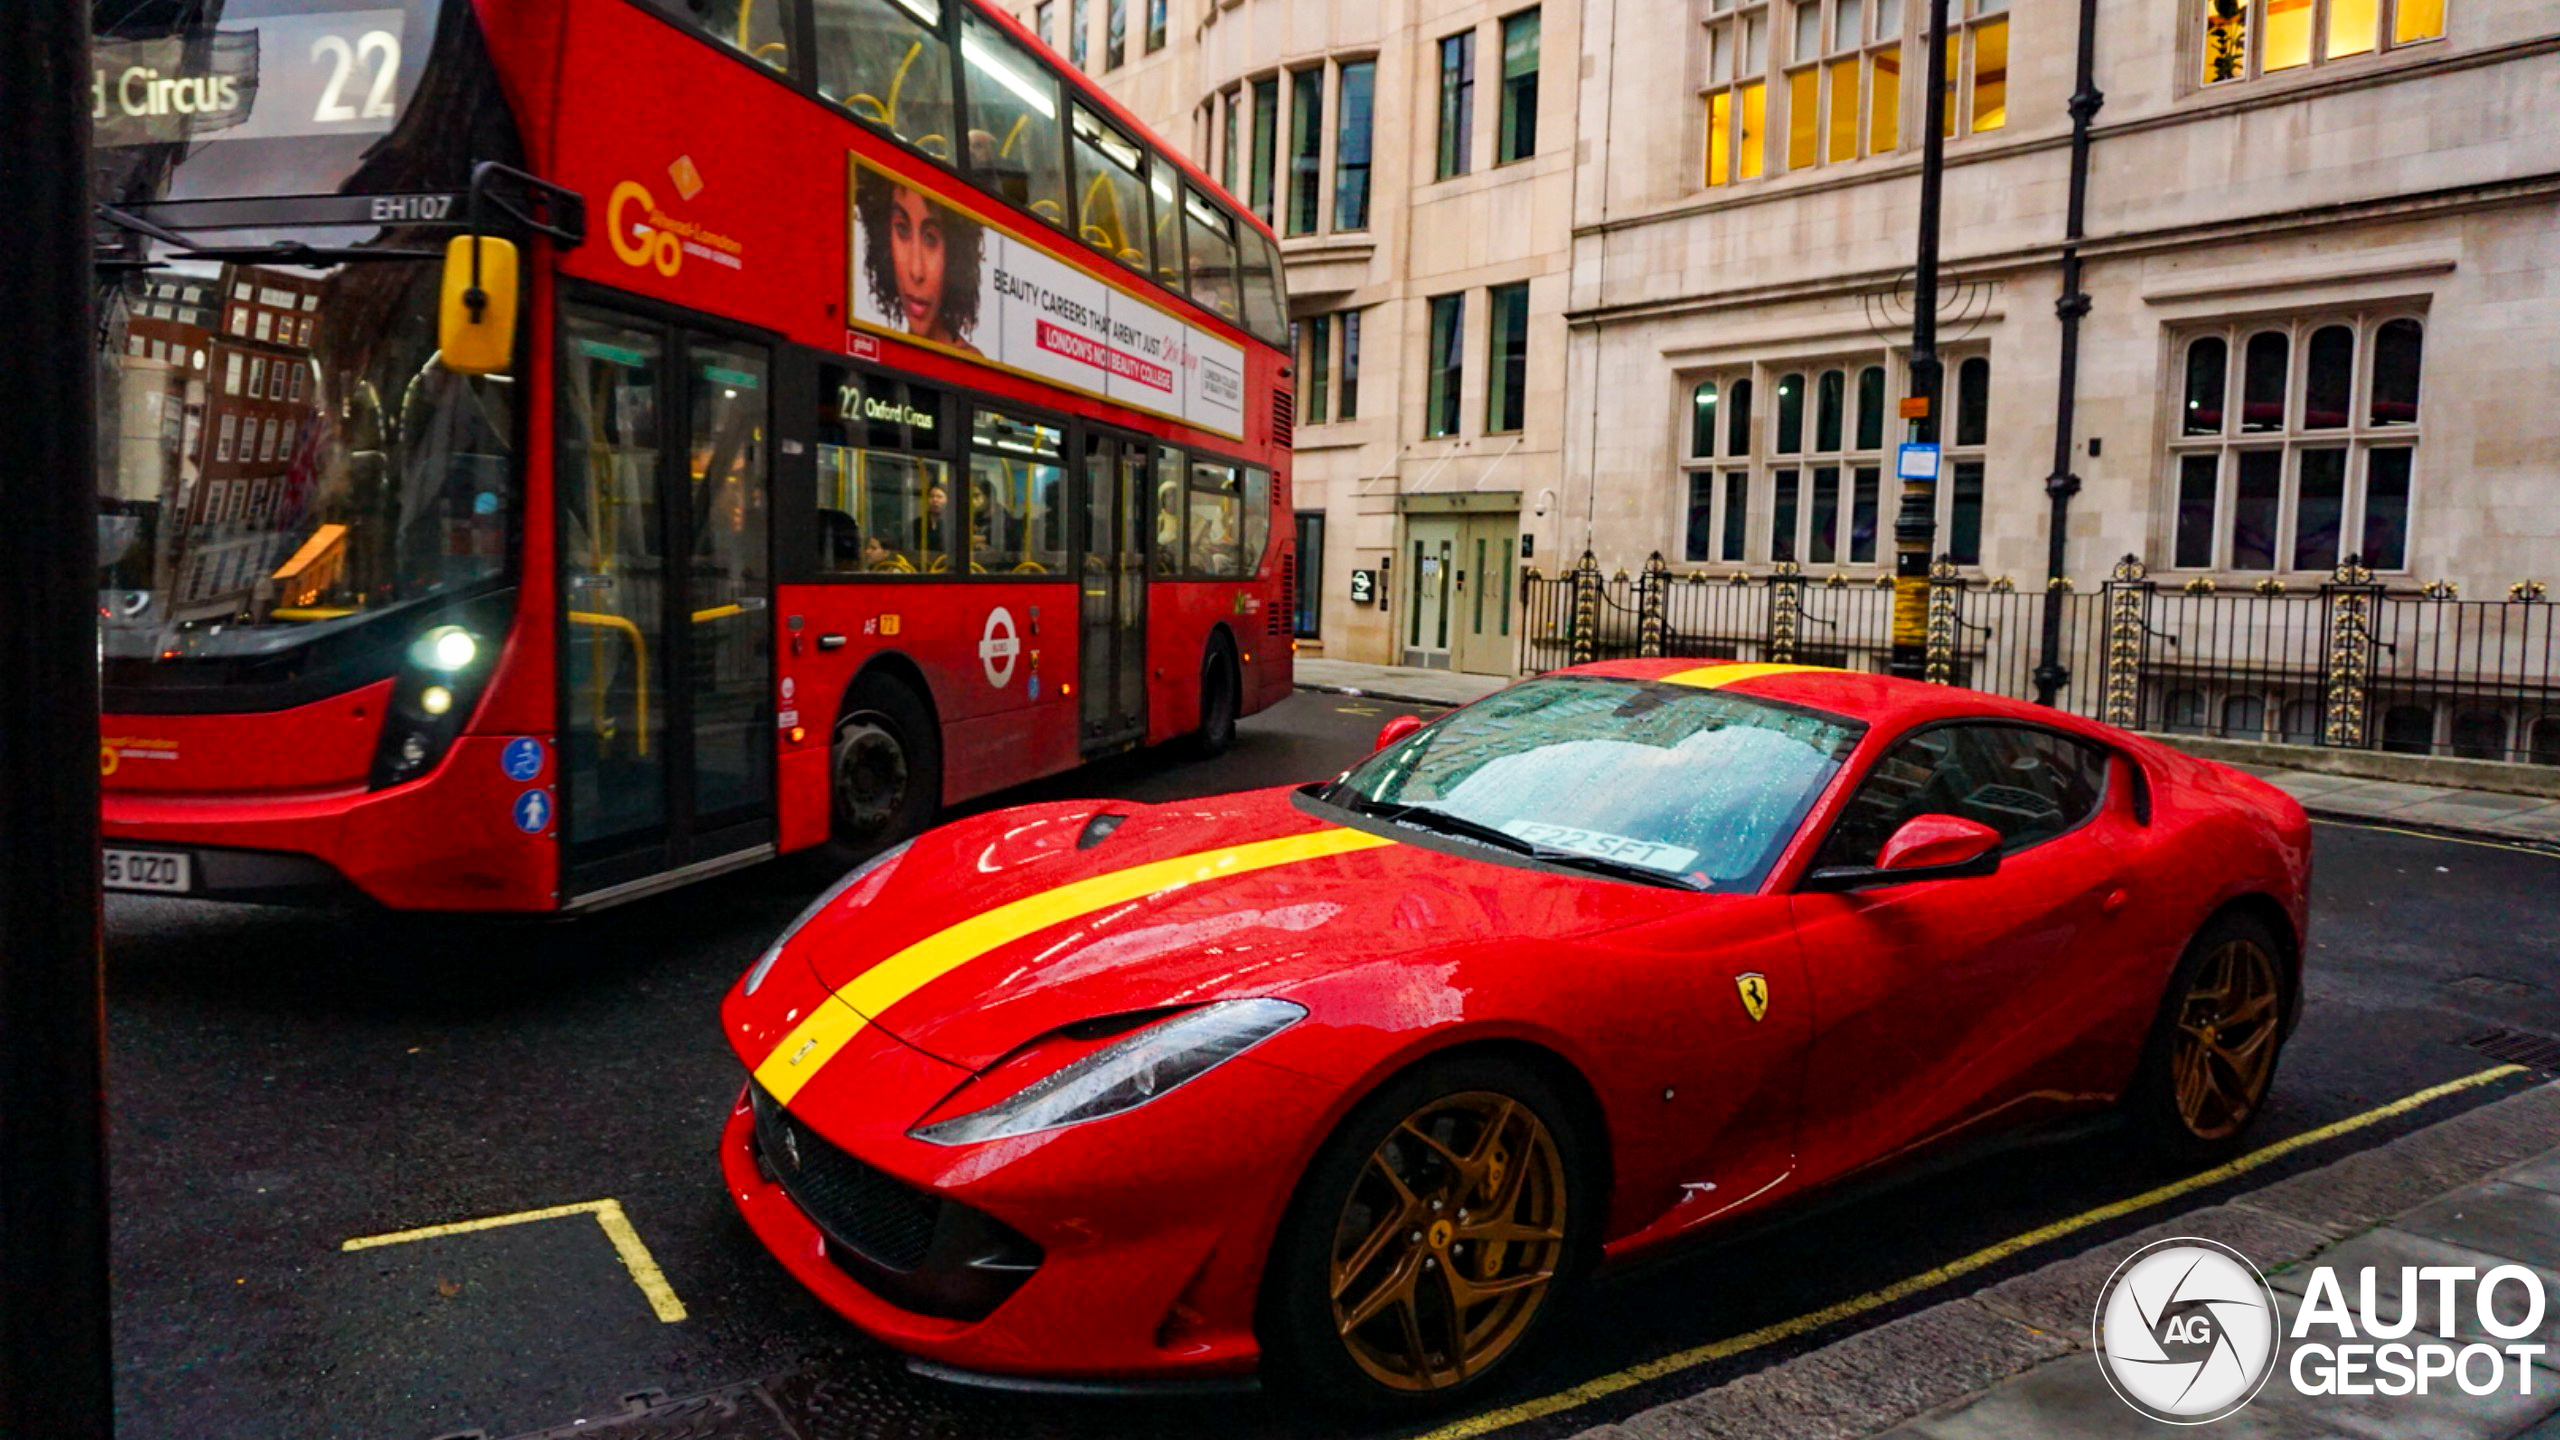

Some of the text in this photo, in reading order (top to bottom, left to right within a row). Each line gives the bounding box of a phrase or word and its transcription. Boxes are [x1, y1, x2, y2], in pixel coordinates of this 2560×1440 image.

[118, 66, 240, 117] Circus
[310, 30, 400, 122] 22
[371, 196, 453, 220] EH107
[607, 180, 682, 277] Go
[993, 268, 1039, 306] BEAUTY
[1041, 289, 1087, 327] CAREERS
[1089, 309, 1111, 336] THAT
[1113, 321, 1141, 349] AREN'T
[1143, 334, 1160, 356] JUST
[1045, 327, 1093, 361] LONDON'S
[1111, 350, 1140, 379] BEAUTY
[1141, 362, 1171, 390] COLLEGE
[839, 385, 934, 429] 22 Oxford Circus
[863, 618, 877, 634] AF
[102, 854, 121, 881] 6
[1591, 837, 1668, 861] SFT
